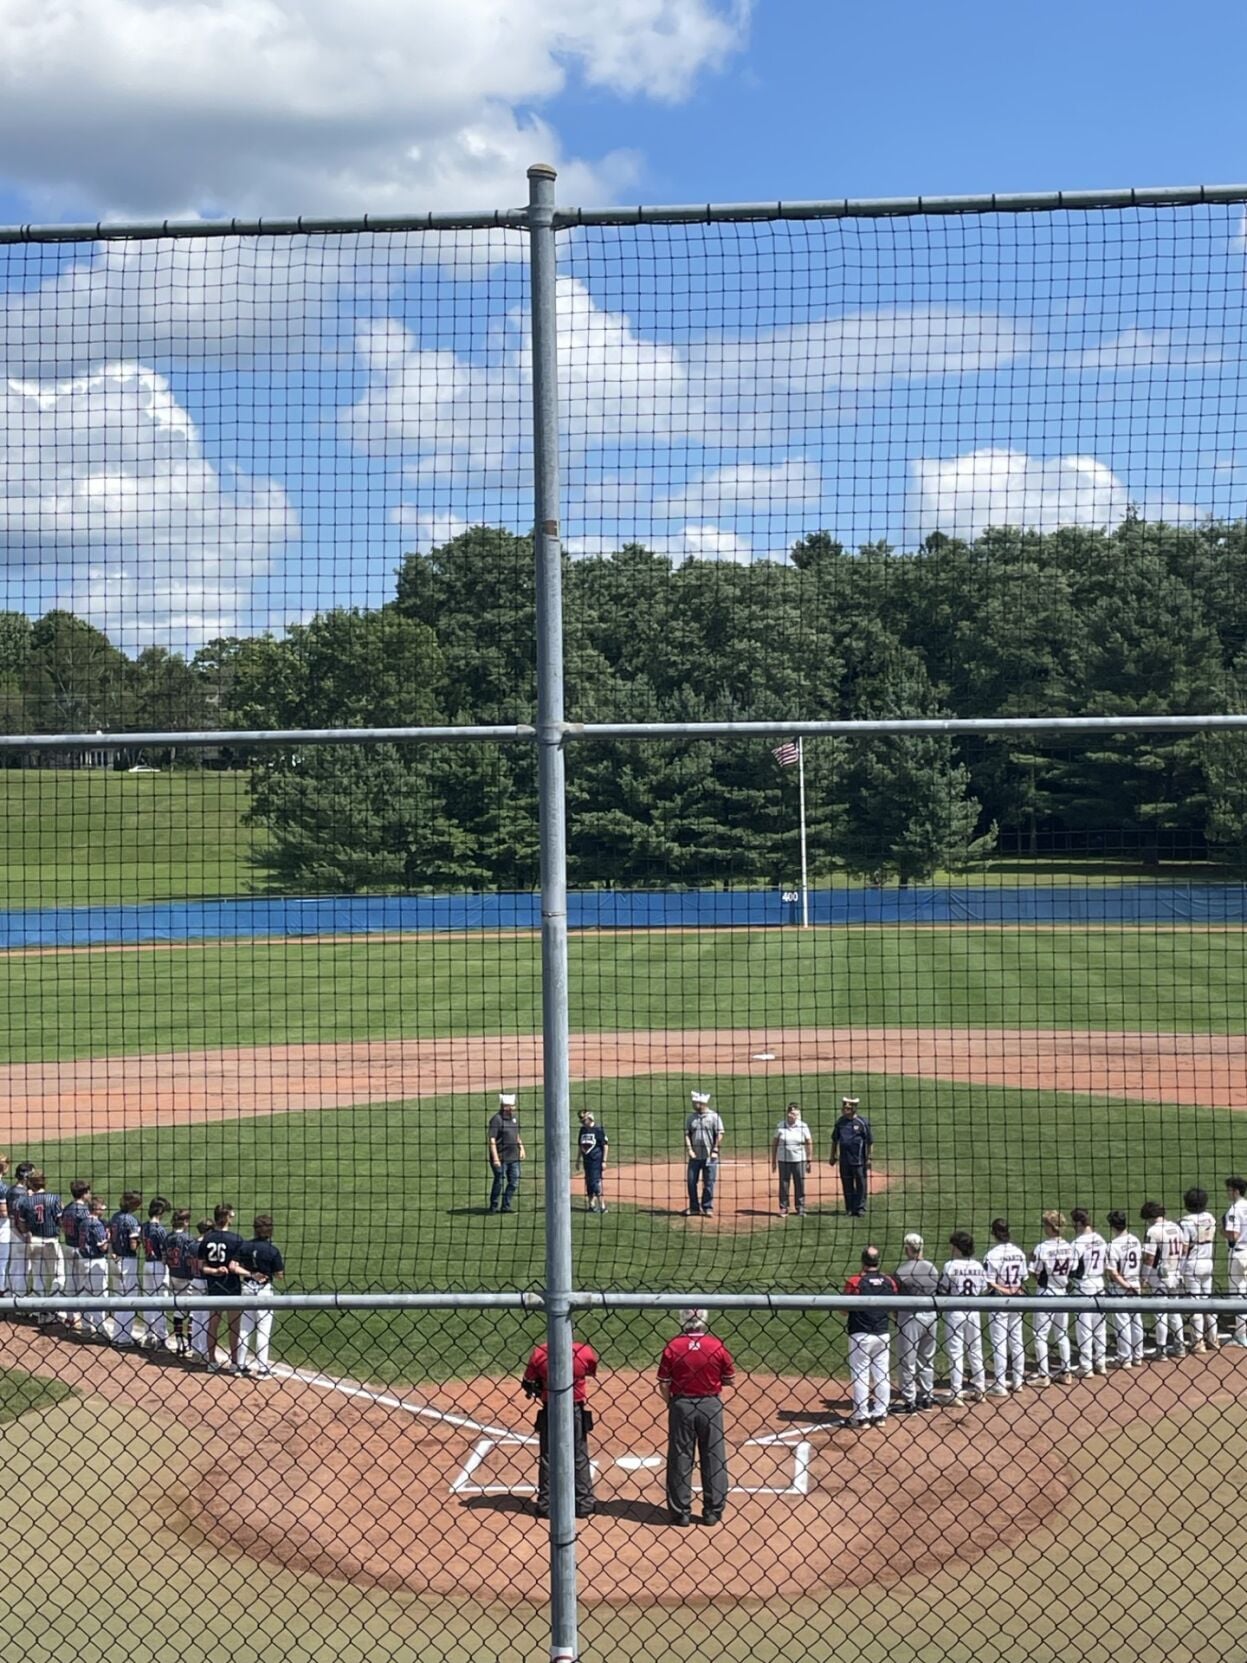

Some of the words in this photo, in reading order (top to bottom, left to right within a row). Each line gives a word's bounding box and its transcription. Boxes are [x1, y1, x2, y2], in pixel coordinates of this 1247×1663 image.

[782, 892, 798, 902] 400
[206, 1242, 227, 1262] 26
[1168, 1237, 1180, 1256] 11
[1053, 1257, 1069, 1276] 44
[1091, 1250, 1100, 1269] 7
[1128, 1251, 1137, 1269] 9
[1004, 1265, 1020, 1285] 17
[963, 1278, 973, 1297] 8
